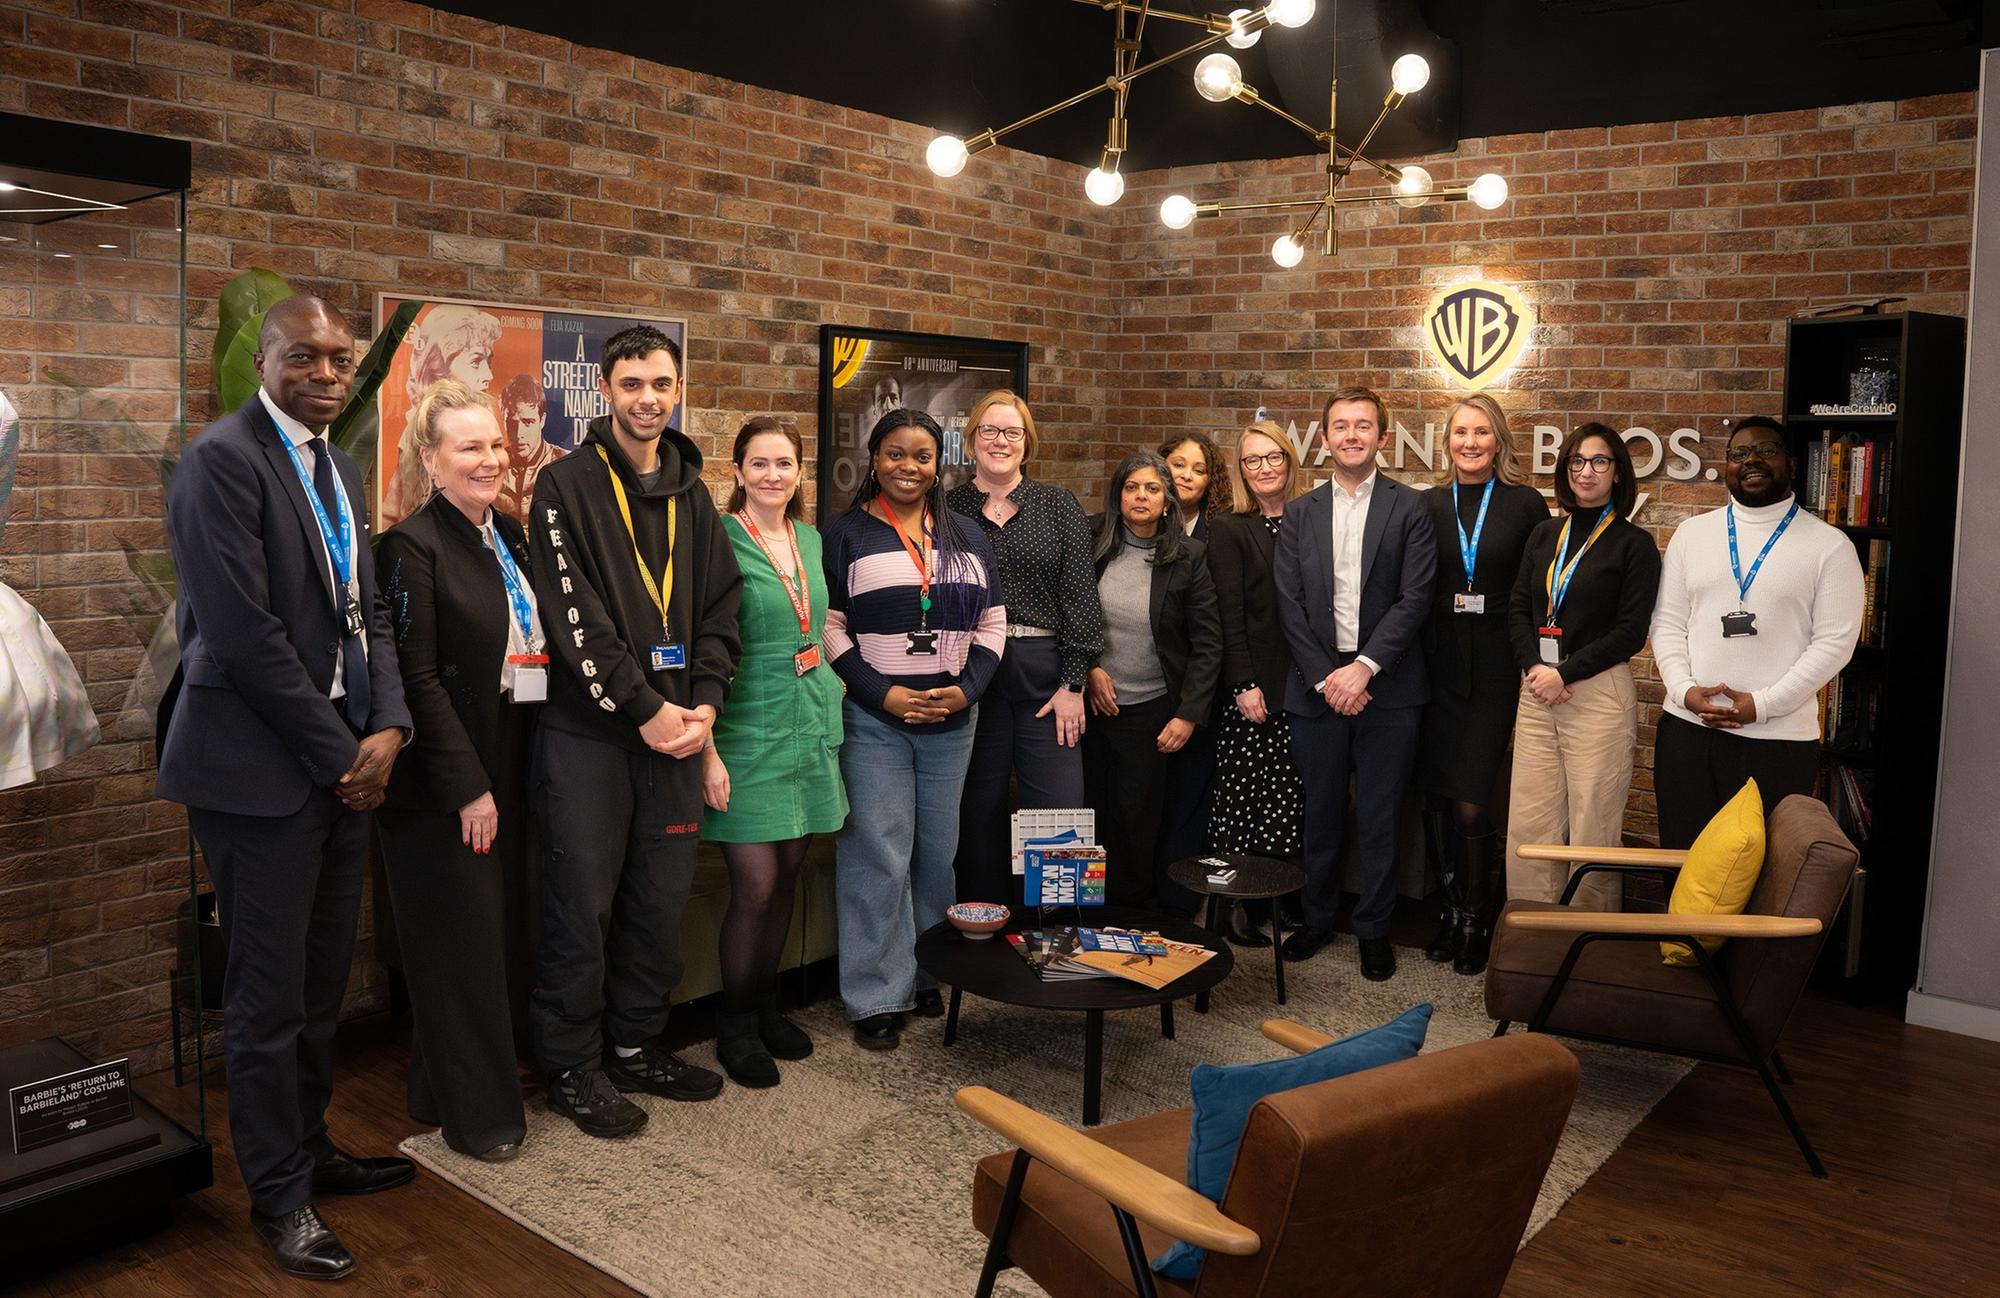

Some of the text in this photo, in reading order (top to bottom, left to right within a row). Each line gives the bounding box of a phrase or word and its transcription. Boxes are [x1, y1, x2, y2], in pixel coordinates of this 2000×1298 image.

[500, 315, 525, 329] COMING
[1434, 295, 1512, 376] WB
[575, 334, 586, 362] A
[543, 361, 601, 390] STREETC
[917, 359, 958, 373] ANNIVERSARY
[1810, 402, 1897, 415] #WeAreCrewHQ
[1532, 425, 1719, 481] BOS.
[546, 508, 616, 712] FEAR OF GOD
[783, 576, 806, 621] HUCKLEBERRY
[19, 1090, 82, 1115] BARBIELAND'
[83, 1078, 125, 1096] COSTUME
[23, 1071, 120, 1104] BARBIE'S 'RETURN TO
